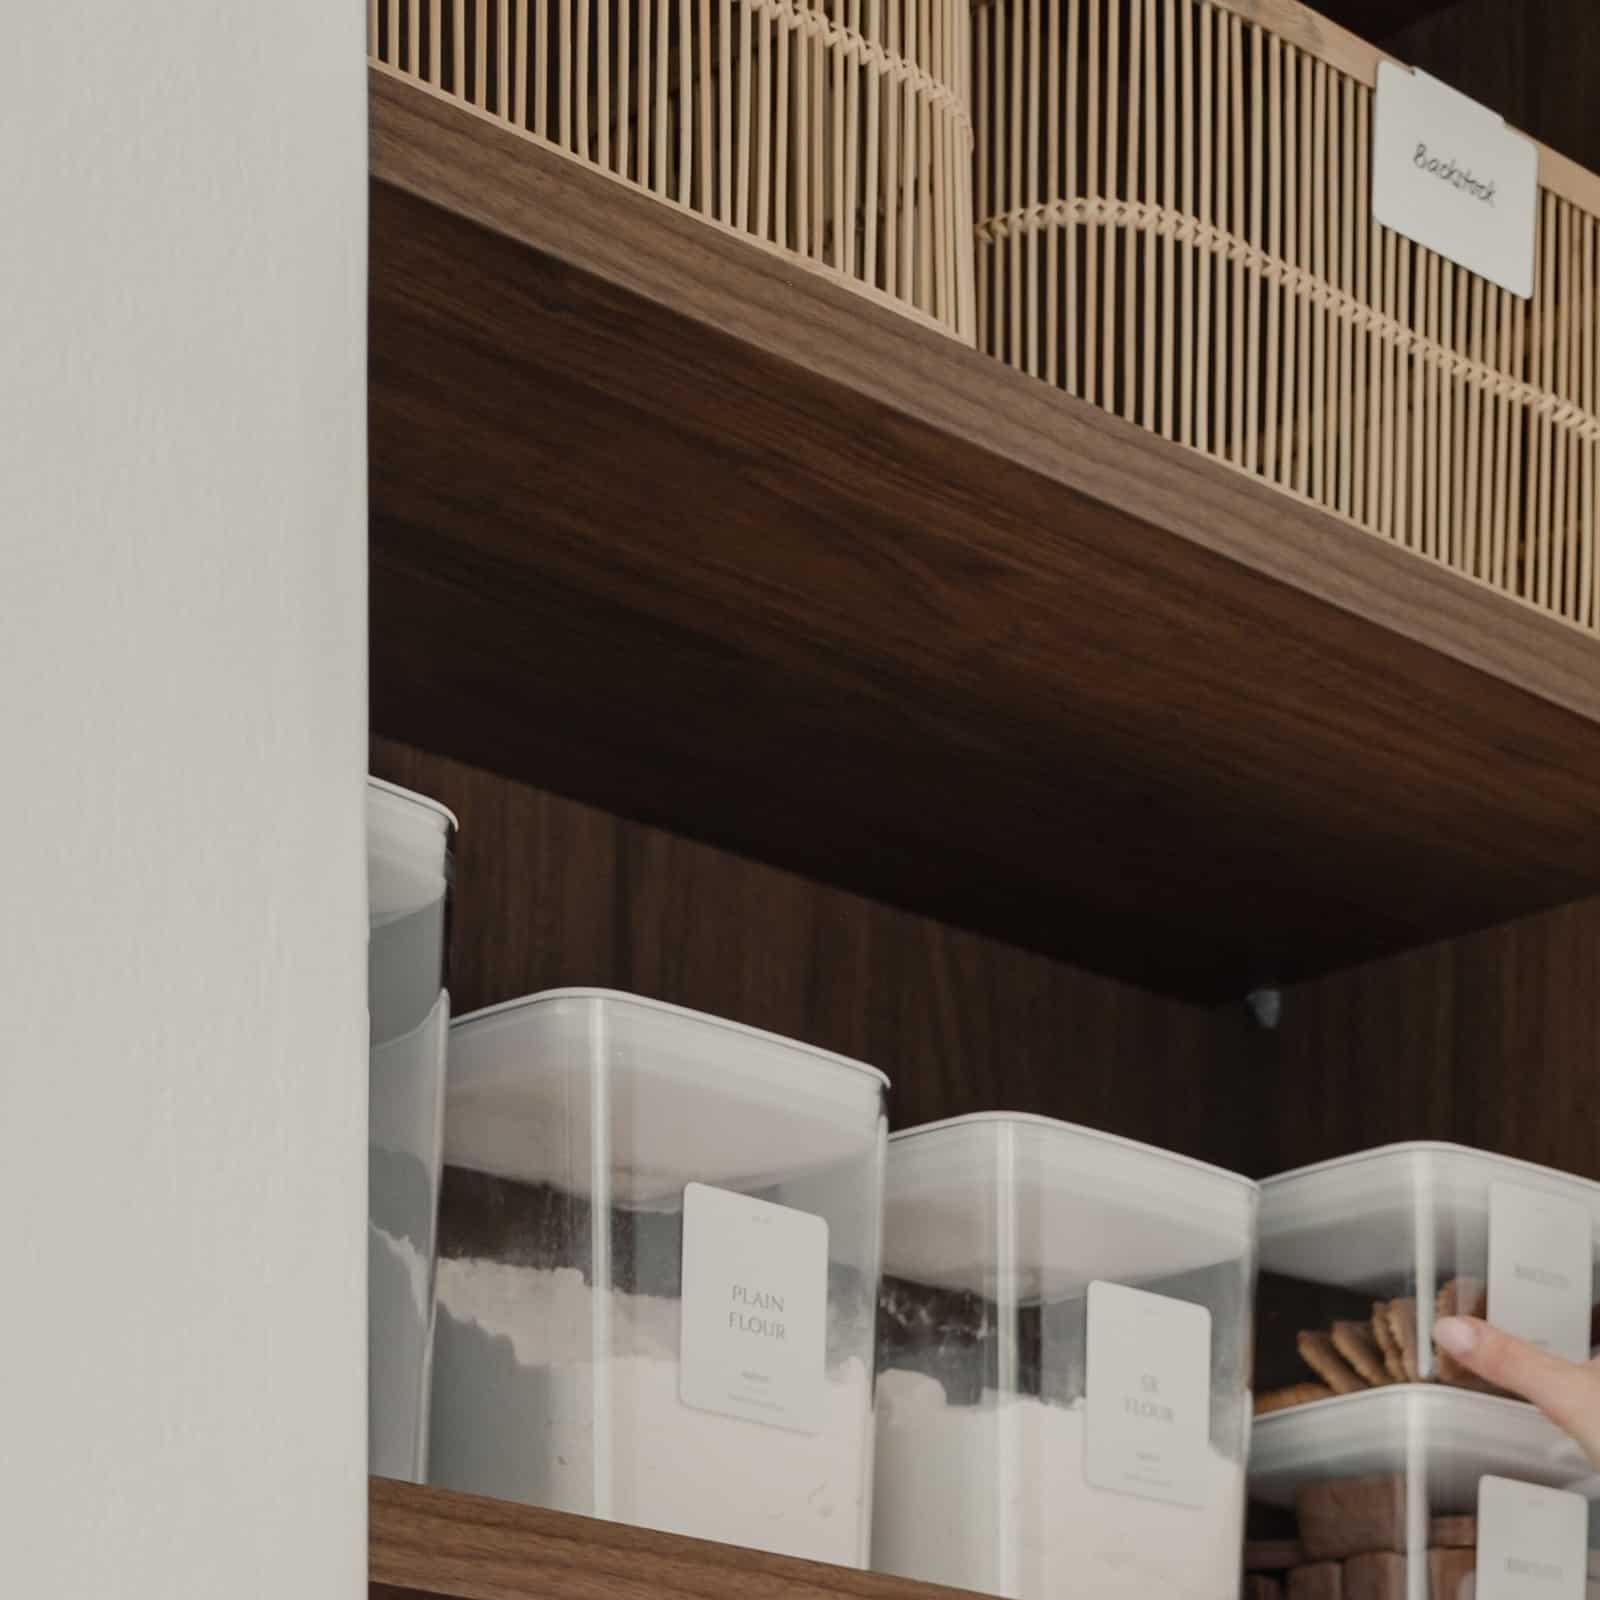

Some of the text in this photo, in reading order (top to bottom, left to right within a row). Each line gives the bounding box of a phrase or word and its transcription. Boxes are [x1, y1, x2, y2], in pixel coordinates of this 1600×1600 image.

[1412, 142, 1496, 208] Backstock
[731, 1284, 786, 1313] PLAIN
[728, 1311, 787, 1341] FLOUR
